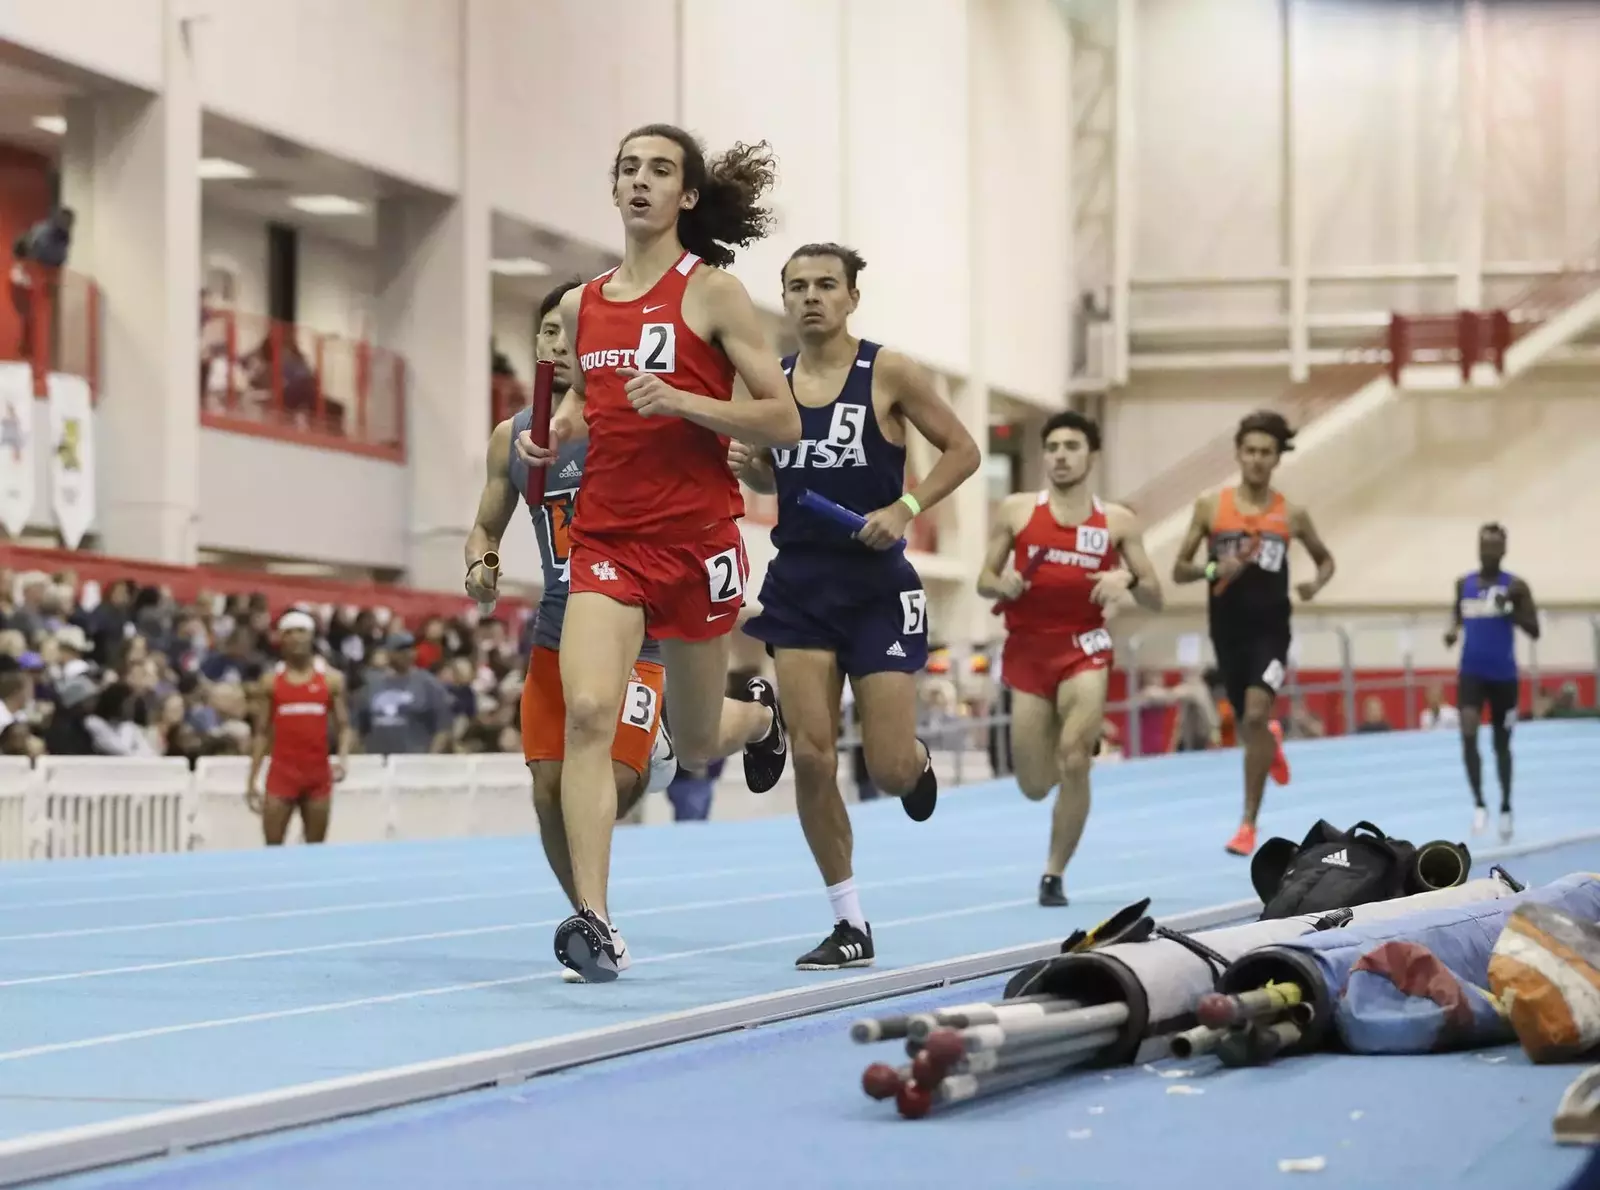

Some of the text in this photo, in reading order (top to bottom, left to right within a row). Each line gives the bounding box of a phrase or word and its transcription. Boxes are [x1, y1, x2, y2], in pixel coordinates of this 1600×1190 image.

[645, 326, 667, 370] 2
[836, 406, 860, 445] 5
[771, 439, 868, 469] UTSA
[558, 470, 583, 479] adidas
[1082, 531, 1104, 550] 10
[713, 555, 737, 600] 2
[907, 593, 920, 632] 5
[629, 685, 652, 725] 3
